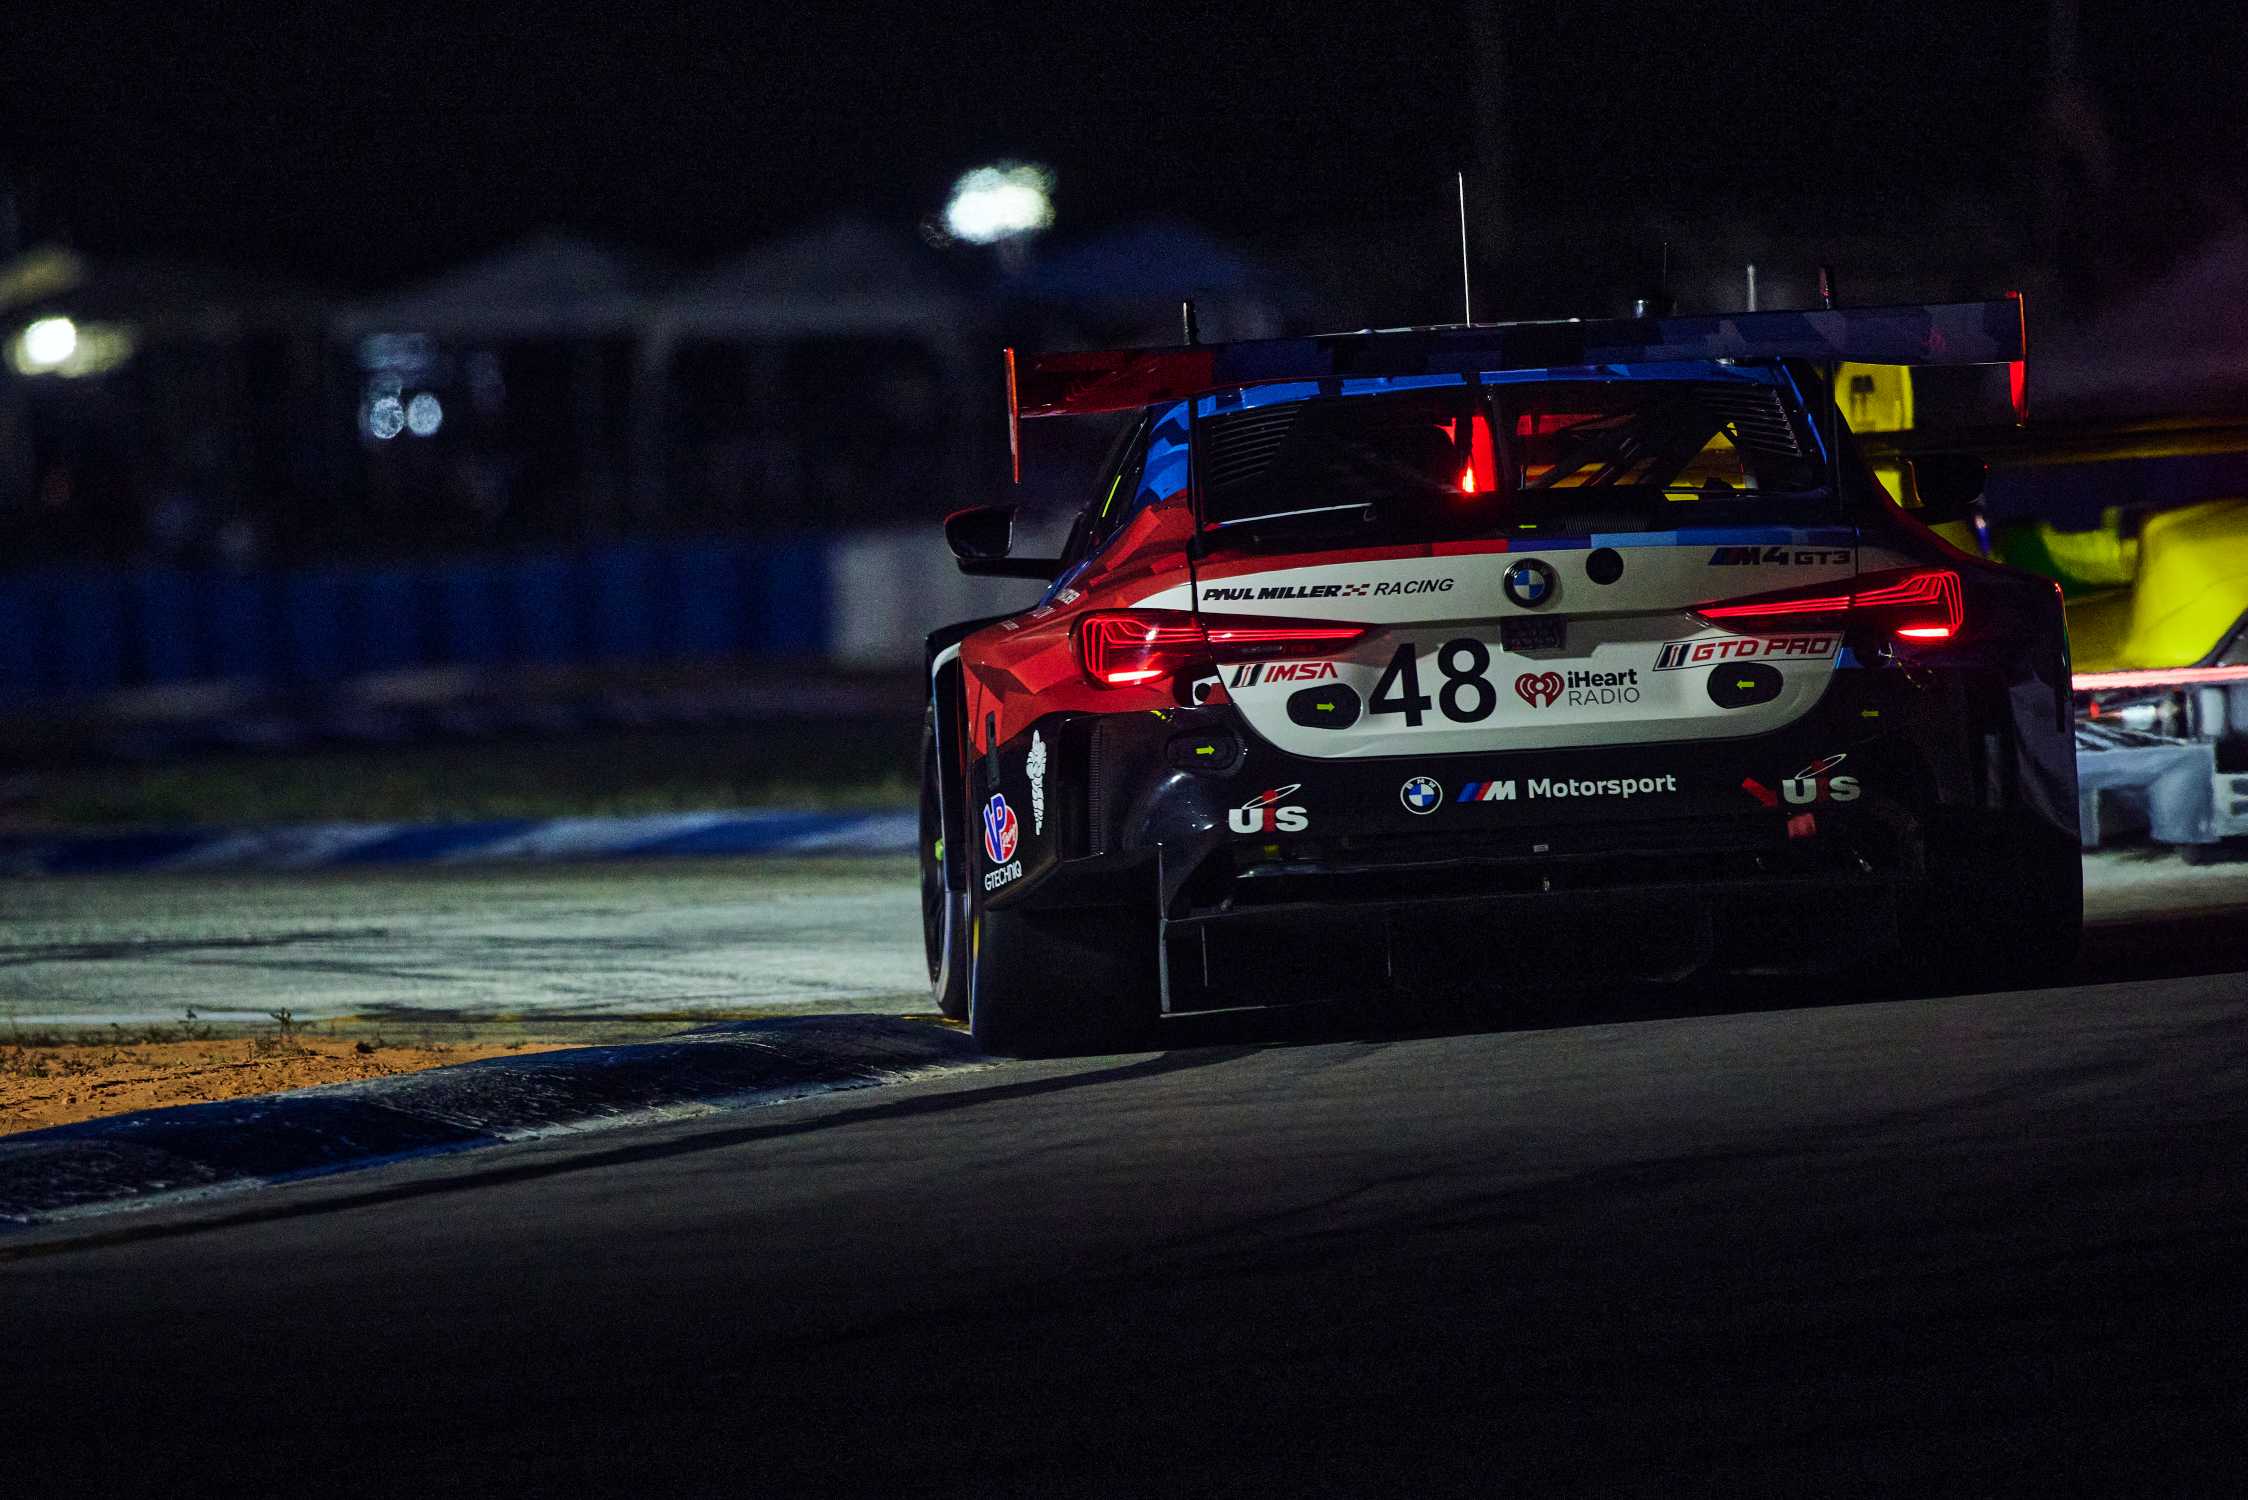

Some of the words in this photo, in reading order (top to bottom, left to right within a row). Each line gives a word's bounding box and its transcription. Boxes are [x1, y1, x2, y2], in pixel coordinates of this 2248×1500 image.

[1203, 588, 1255, 601] PAUL
[1257, 584, 1343, 600] MILLER
[1373, 578, 1455, 597] RACING
[1691, 638, 1760, 662] GTD
[1763, 637, 1834, 656] PRO
[1264, 662, 1339, 683] IMSA
[1369, 638, 1497, 728] 48
[1567, 668, 1638, 688] iHeart
[1568, 687, 1640, 706] RADIO
[1527, 774, 1677, 799] Motorsport
